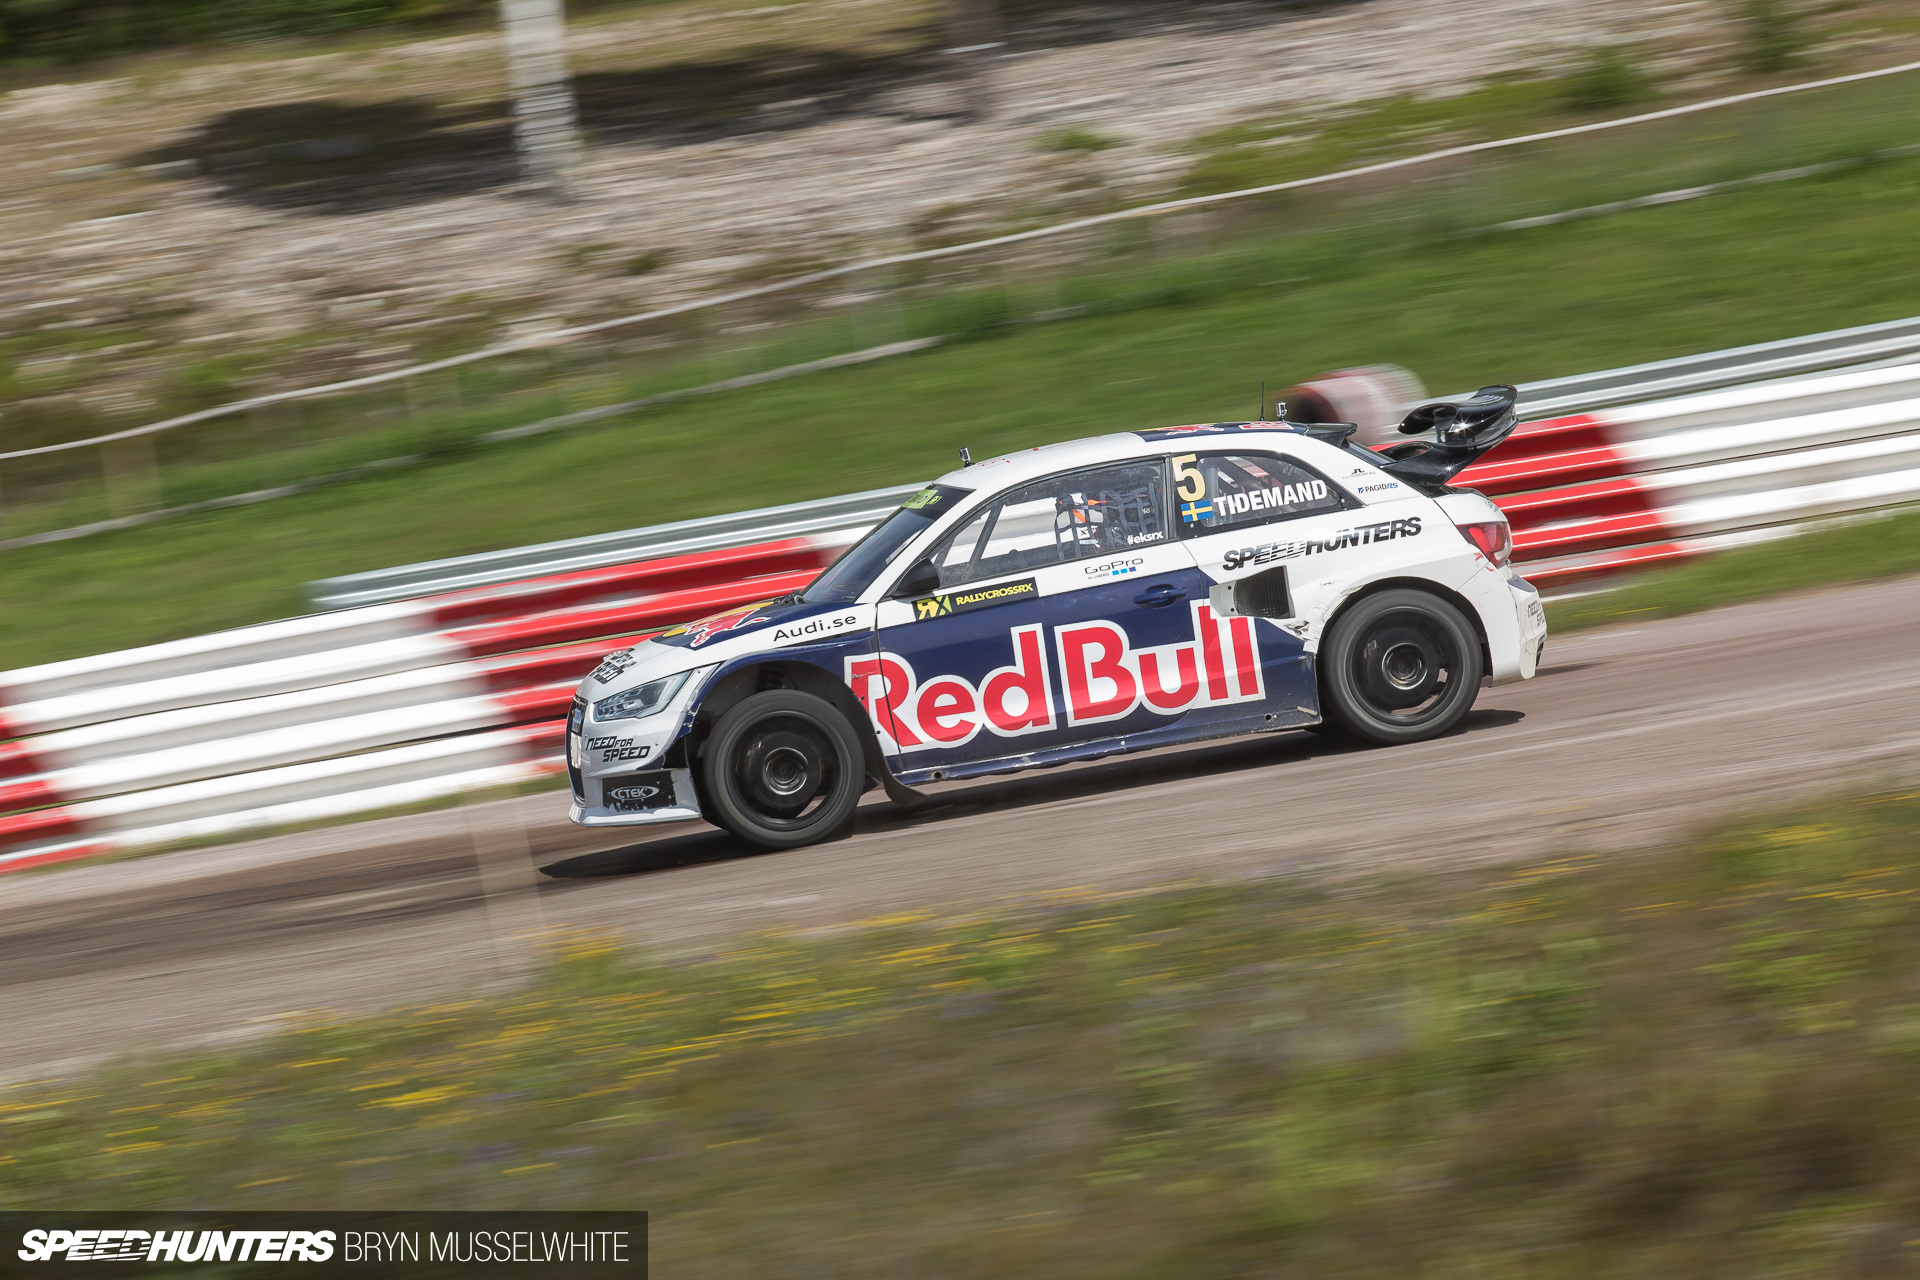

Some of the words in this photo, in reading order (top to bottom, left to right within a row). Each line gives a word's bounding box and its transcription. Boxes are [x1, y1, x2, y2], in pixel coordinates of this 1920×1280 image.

[1172, 453, 1206, 502] 5
[1213, 479, 1328, 516] TIDEMAND
[1127, 531, 1164, 545] #eksrx
[1222, 516, 1422, 571] SPEEDHUNTERS
[1085, 558, 1143, 575] GoPro
[955, 583, 1034, 606] RALLYCROSSRX
[773, 615, 857, 642] Audi.se
[846, 625, 1055, 752] Red
[1057, 601, 1263, 726] Bull
[586, 736, 617, 751] NEED
[614, 738, 634, 748] FOR
[602, 746, 651, 763] SPEED
[617, 787, 647, 799] CTEK
